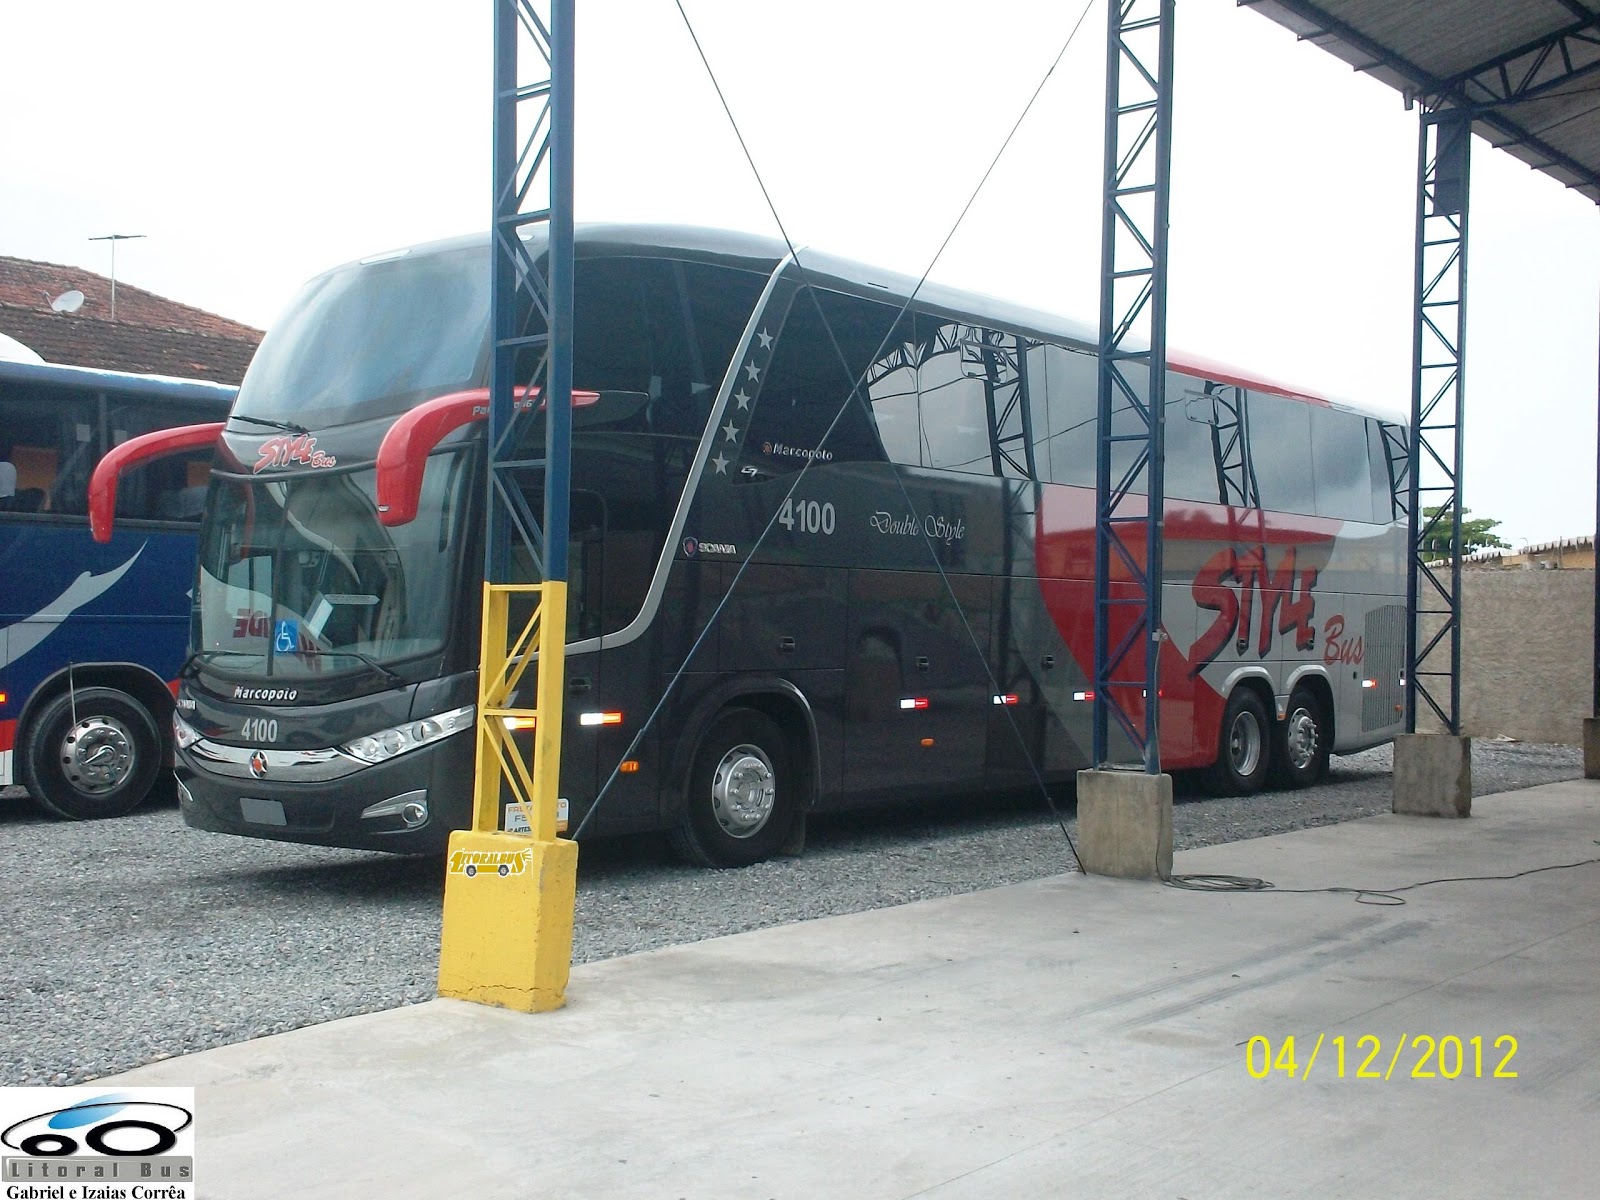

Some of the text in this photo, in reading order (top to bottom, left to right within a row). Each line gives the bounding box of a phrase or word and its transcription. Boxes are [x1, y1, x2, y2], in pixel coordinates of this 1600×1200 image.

[253, 434, 337, 475] STYLE Bus
[773, 443, 833, 460] Marcopolo
[778, 497, 836, 535] 4100
[869, 509, 965, 546] Double Style
[1187, 544, 1364, 681] STYLE Bus
[234, 686, 298, 701] Marcopolo
[241, 718, 278, 743] 4100
